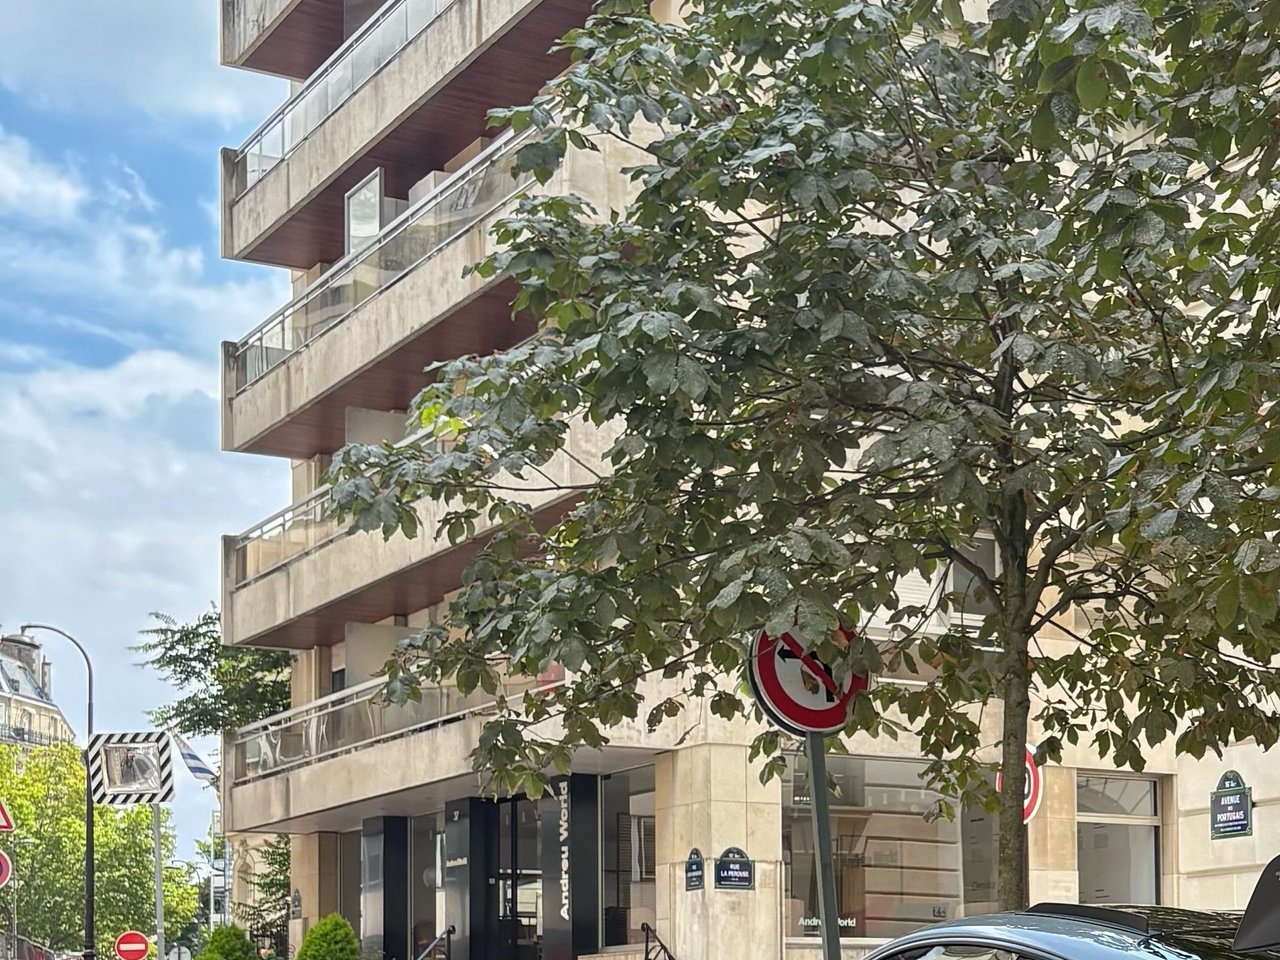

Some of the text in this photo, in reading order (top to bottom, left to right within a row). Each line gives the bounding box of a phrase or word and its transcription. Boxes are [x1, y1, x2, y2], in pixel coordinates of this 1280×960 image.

[1221, 795, 1240, 805] AVENUE
[1217, 811, 1244, 822] PORTUGAIS
[559, 781, 570, 921] Andreu World
